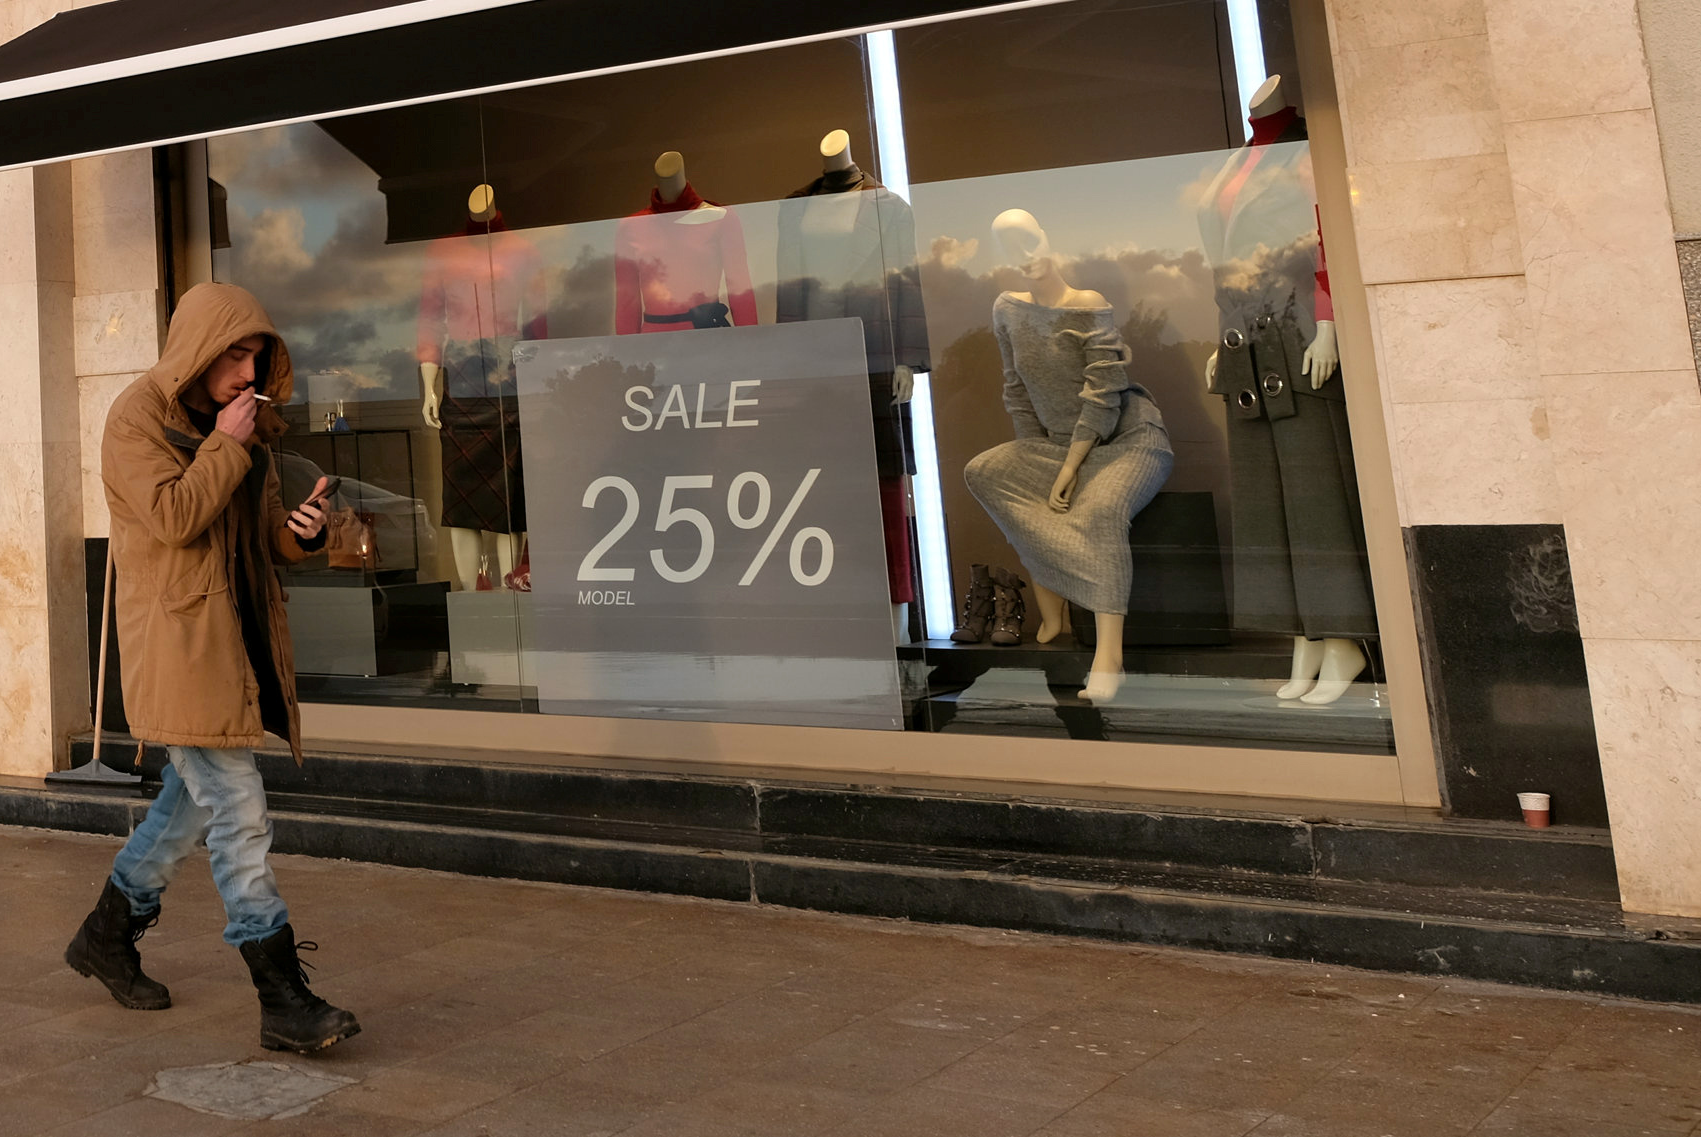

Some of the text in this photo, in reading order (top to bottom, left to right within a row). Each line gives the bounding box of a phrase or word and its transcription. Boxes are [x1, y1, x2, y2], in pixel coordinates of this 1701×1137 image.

[620, 379, 762, 432] SALE
[576, 467, 835, 587] 25%
[577, 590, 636, 606] MODEL
